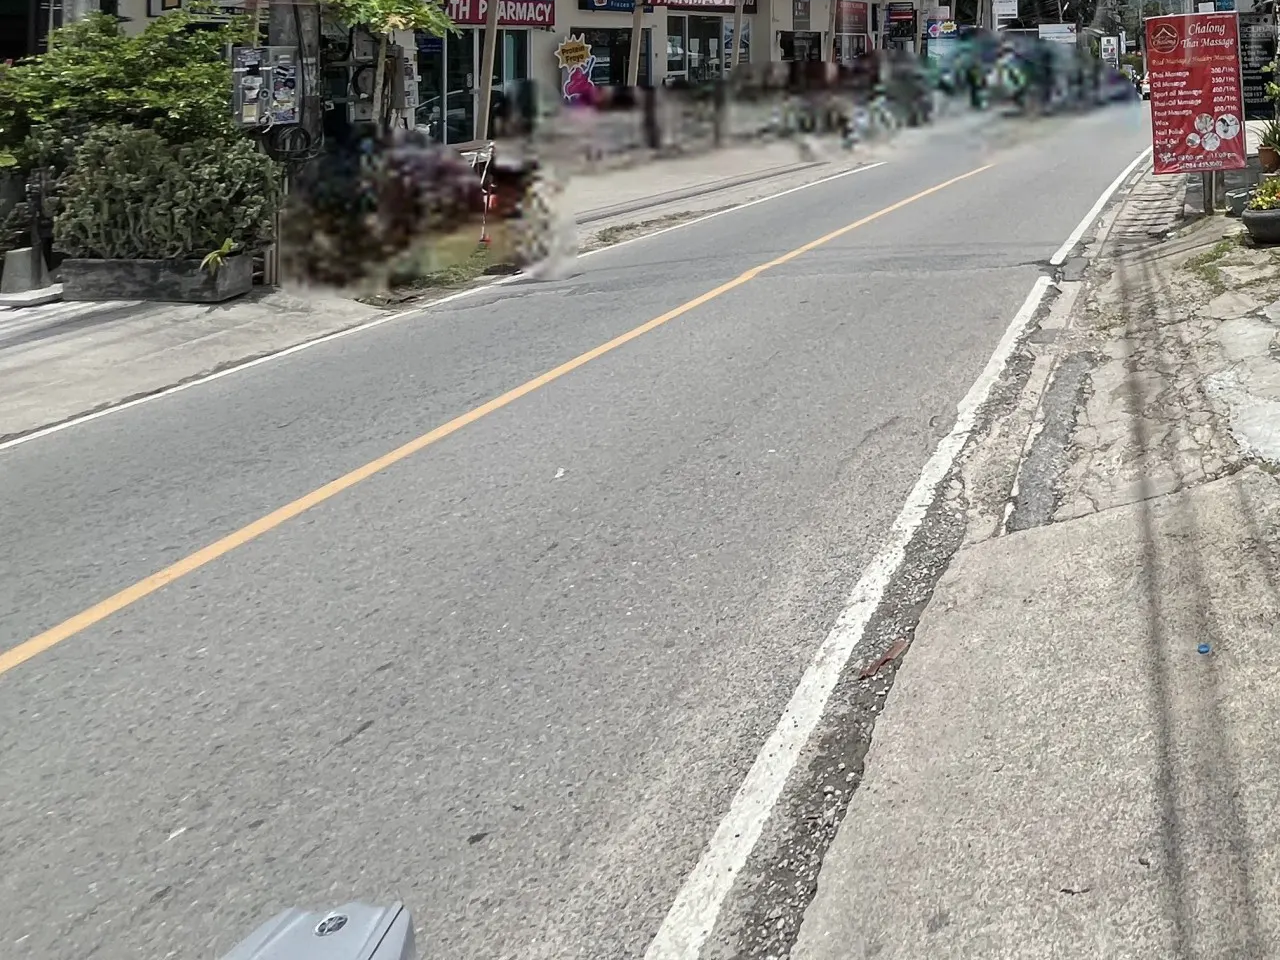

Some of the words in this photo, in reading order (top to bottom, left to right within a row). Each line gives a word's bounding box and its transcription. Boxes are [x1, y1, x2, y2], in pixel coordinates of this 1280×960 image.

[479, 0, 552, 22] PARMACY
[1188, 21, 1226, 36] Chalong
[1181, 38, 1199, 48] Thai
[1201, 38, 1234, 49] Massage
[561, 44, 585, 55] Protein
[1152, 71, 1164, 79] Thai
